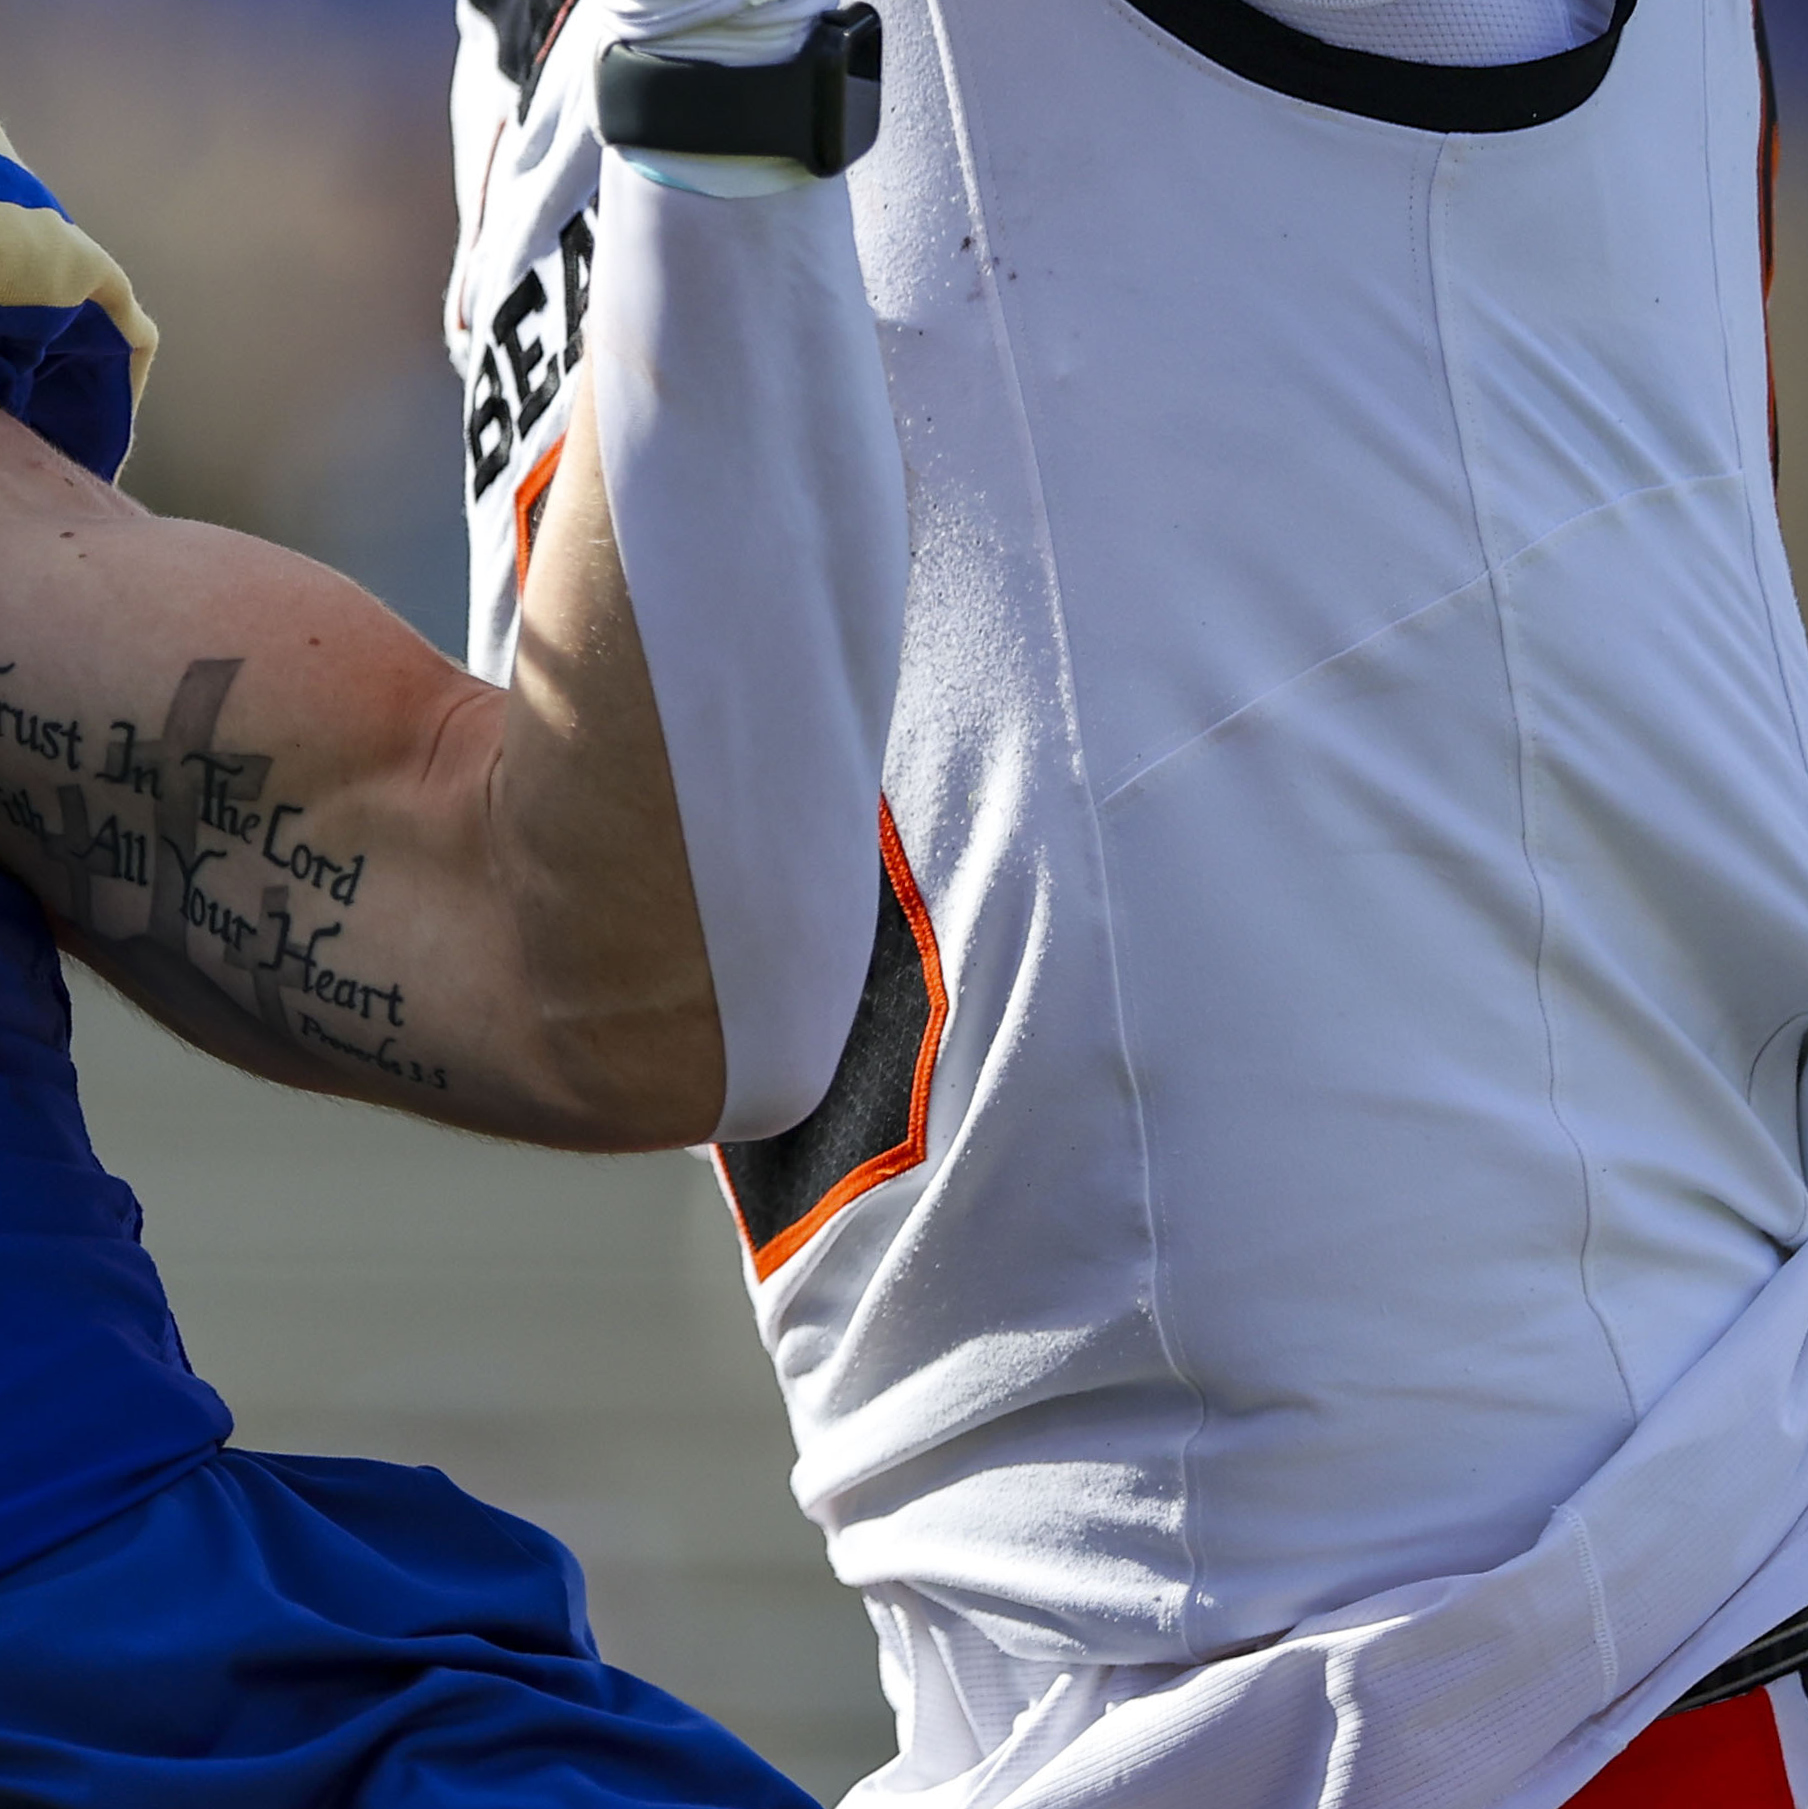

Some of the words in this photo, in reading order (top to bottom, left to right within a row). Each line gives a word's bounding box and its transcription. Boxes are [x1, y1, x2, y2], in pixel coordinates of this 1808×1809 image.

[95, 721, 161, 800] In
[181, 752, 261, 846] The
[261, 804, 366, 908] Lord
[71, 814, 148, 887] All
[160, 835, 258, 952] Your
[259, 910, 405, 1028] Heart
